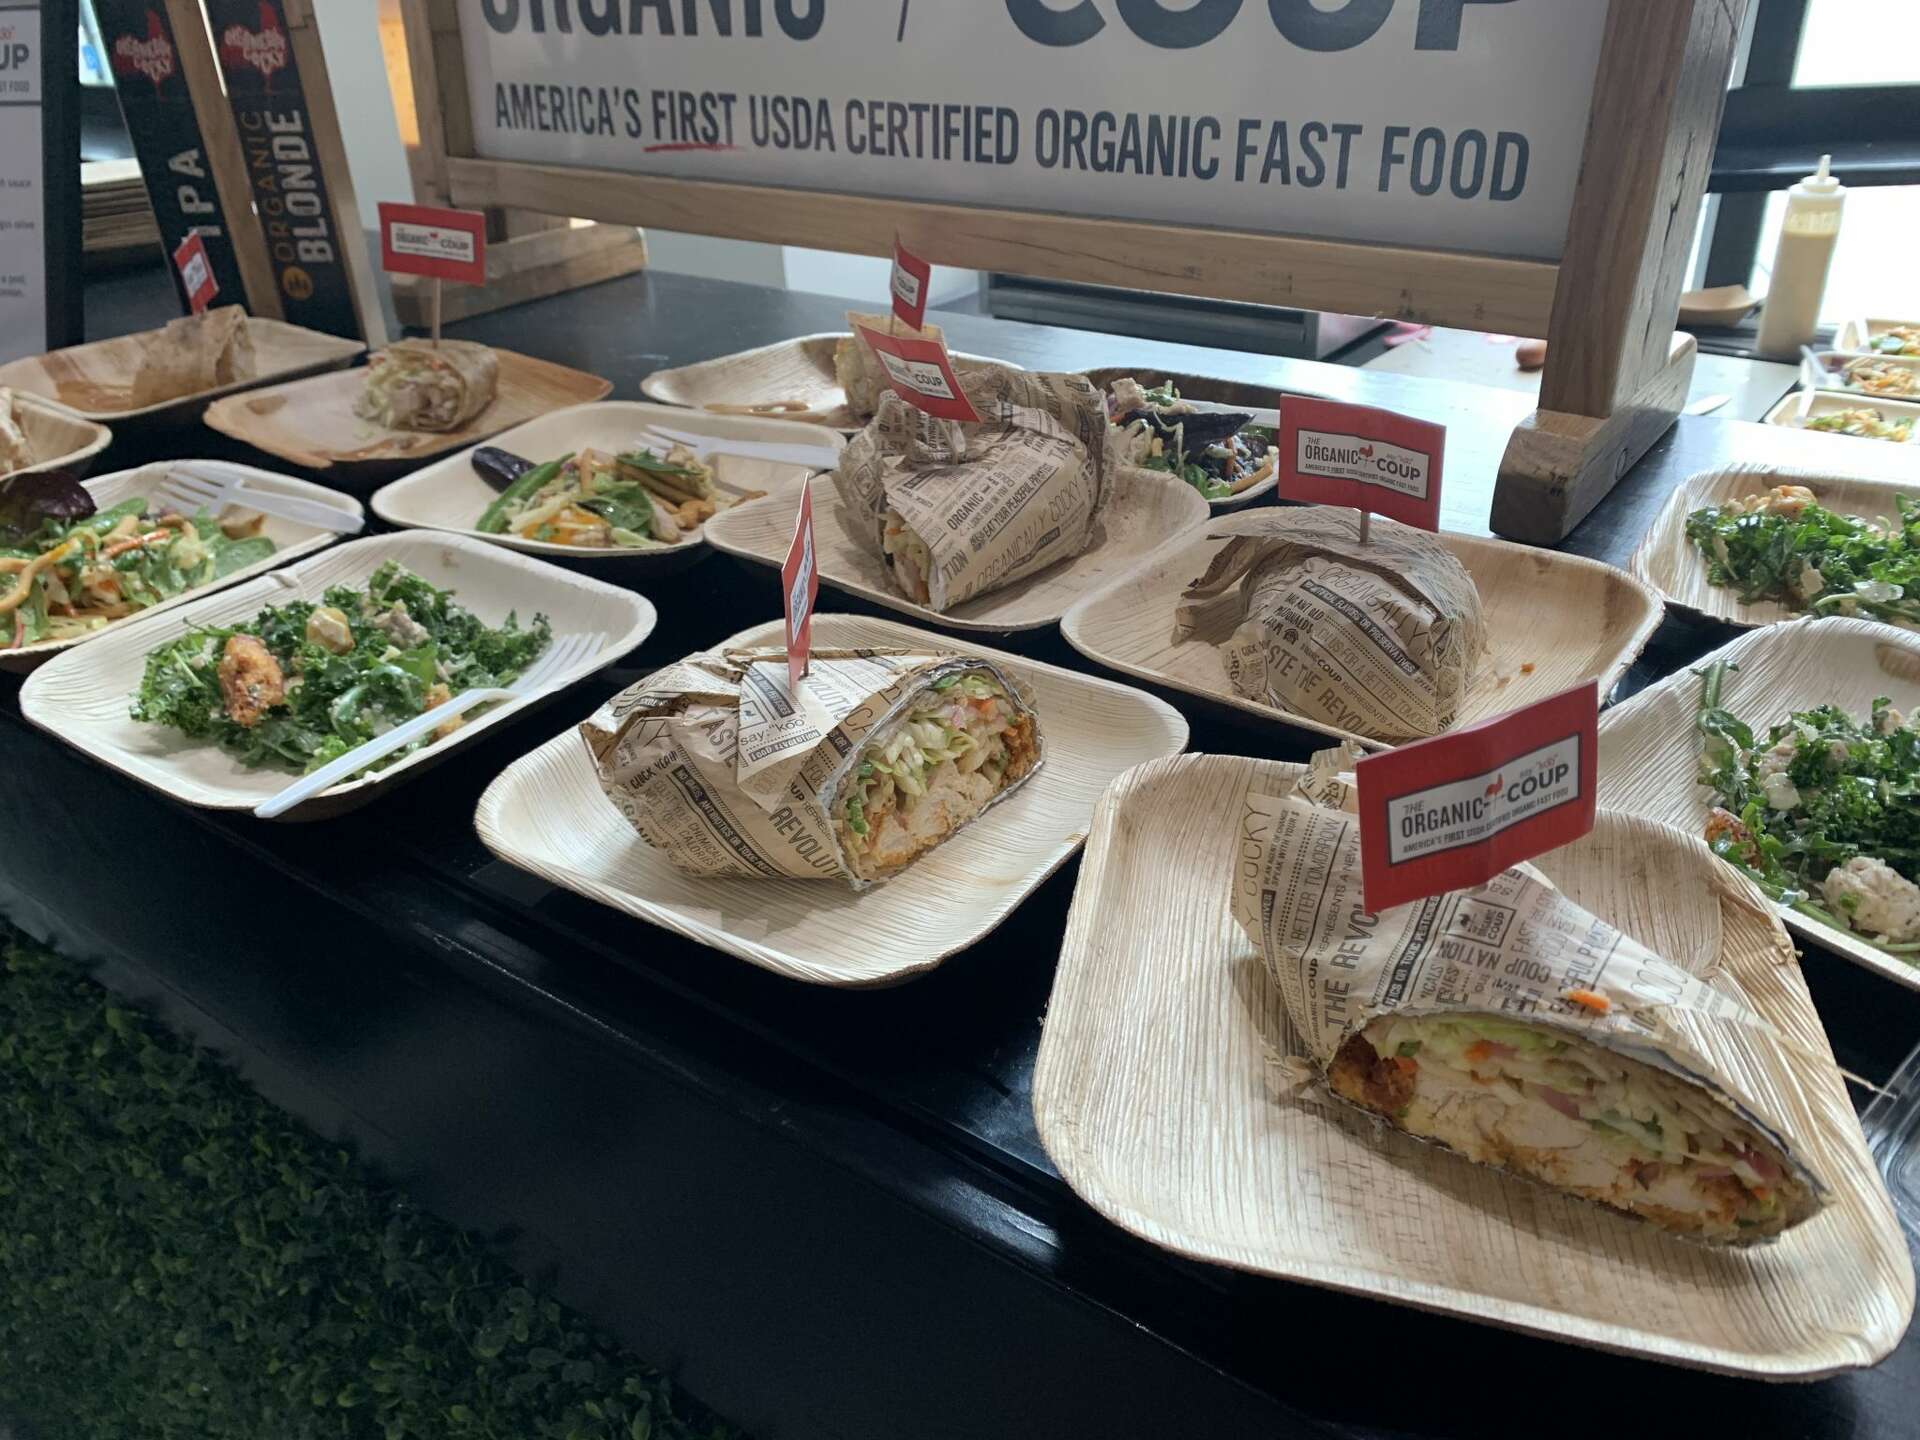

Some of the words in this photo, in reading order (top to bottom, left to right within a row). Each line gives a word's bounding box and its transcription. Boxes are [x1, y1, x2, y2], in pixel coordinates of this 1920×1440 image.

[496, 82, 641, 140] AMERICA'S
[651, 90, 736, 146] FIRST
[748, 95, 835, 152] USDA
[845, 99, 1018, 165] CERTIFIED
[1034, 107, 1220, 180] ORGANIC
[1235, 118, 1362, 189] FAST
[1378, 126, 1529, 201] FOOD
[241, 111, 296, 262] ORGANIC
[264, 109, 333, 262] BLONDE
[914, 373, 943, 387] COUP
[1304, 444, 1359, 465] ORGANIC
[1376, 458, 1421, 480] COUP
[945, 490, 984, 531] ORGANIC
[981, 520, 999, 538] EAT
[991, 505, 1011, 526] YOUR
[1004, 480, 1034, 512] PEACEFUL
[1358, 616, 1372, 630] OR
[1366, 625, 1416, 675] PRESERVATIVES
[1316, 657, 1342, 684] COUP
[1362, 669, 1396, 704] BETTER
[1401, 799, 1484, 839] ORGANIC
[1507, 763, 1569, 803] COUP
[1403, 801, 1424, 815] THE
[676, 827, 714, 869] CALORIES
[686, 820, 725, 864] CHEMICALS
[1243, 801, 1272, 895] COCKY
[1272, 861, 1285, 886] SPEAK
[1279, 838, 1291, 859] WITH
[1285, 818, 1298, 834] YOUR
[1305, 816, 1340, 886] TOMORROW
[1342, 843, 1359, 872] NEW
[1403, 836, 1442, 853] AMERICA'S
[1443, 830, 1465, 845] FIRST
[1339, 872, 1350, 882] A
[1290, 890, 1318, 942] BETTER
[1316, 883, 1347, 957] REPRESENTS
[1487, 911, 1507, 941] COUP
[1282, 941, 1301, 952] A
[1401, 940, 1422, 968] TOXIC
[1435, 930, 1502, 980] NATION
[1310, 958, 1319, 998] COUP
[1396, 967, 1410, 982] OR
[1503, 949, 1554, 988] COUP
[1323, 979, 1350, 1027] THE
